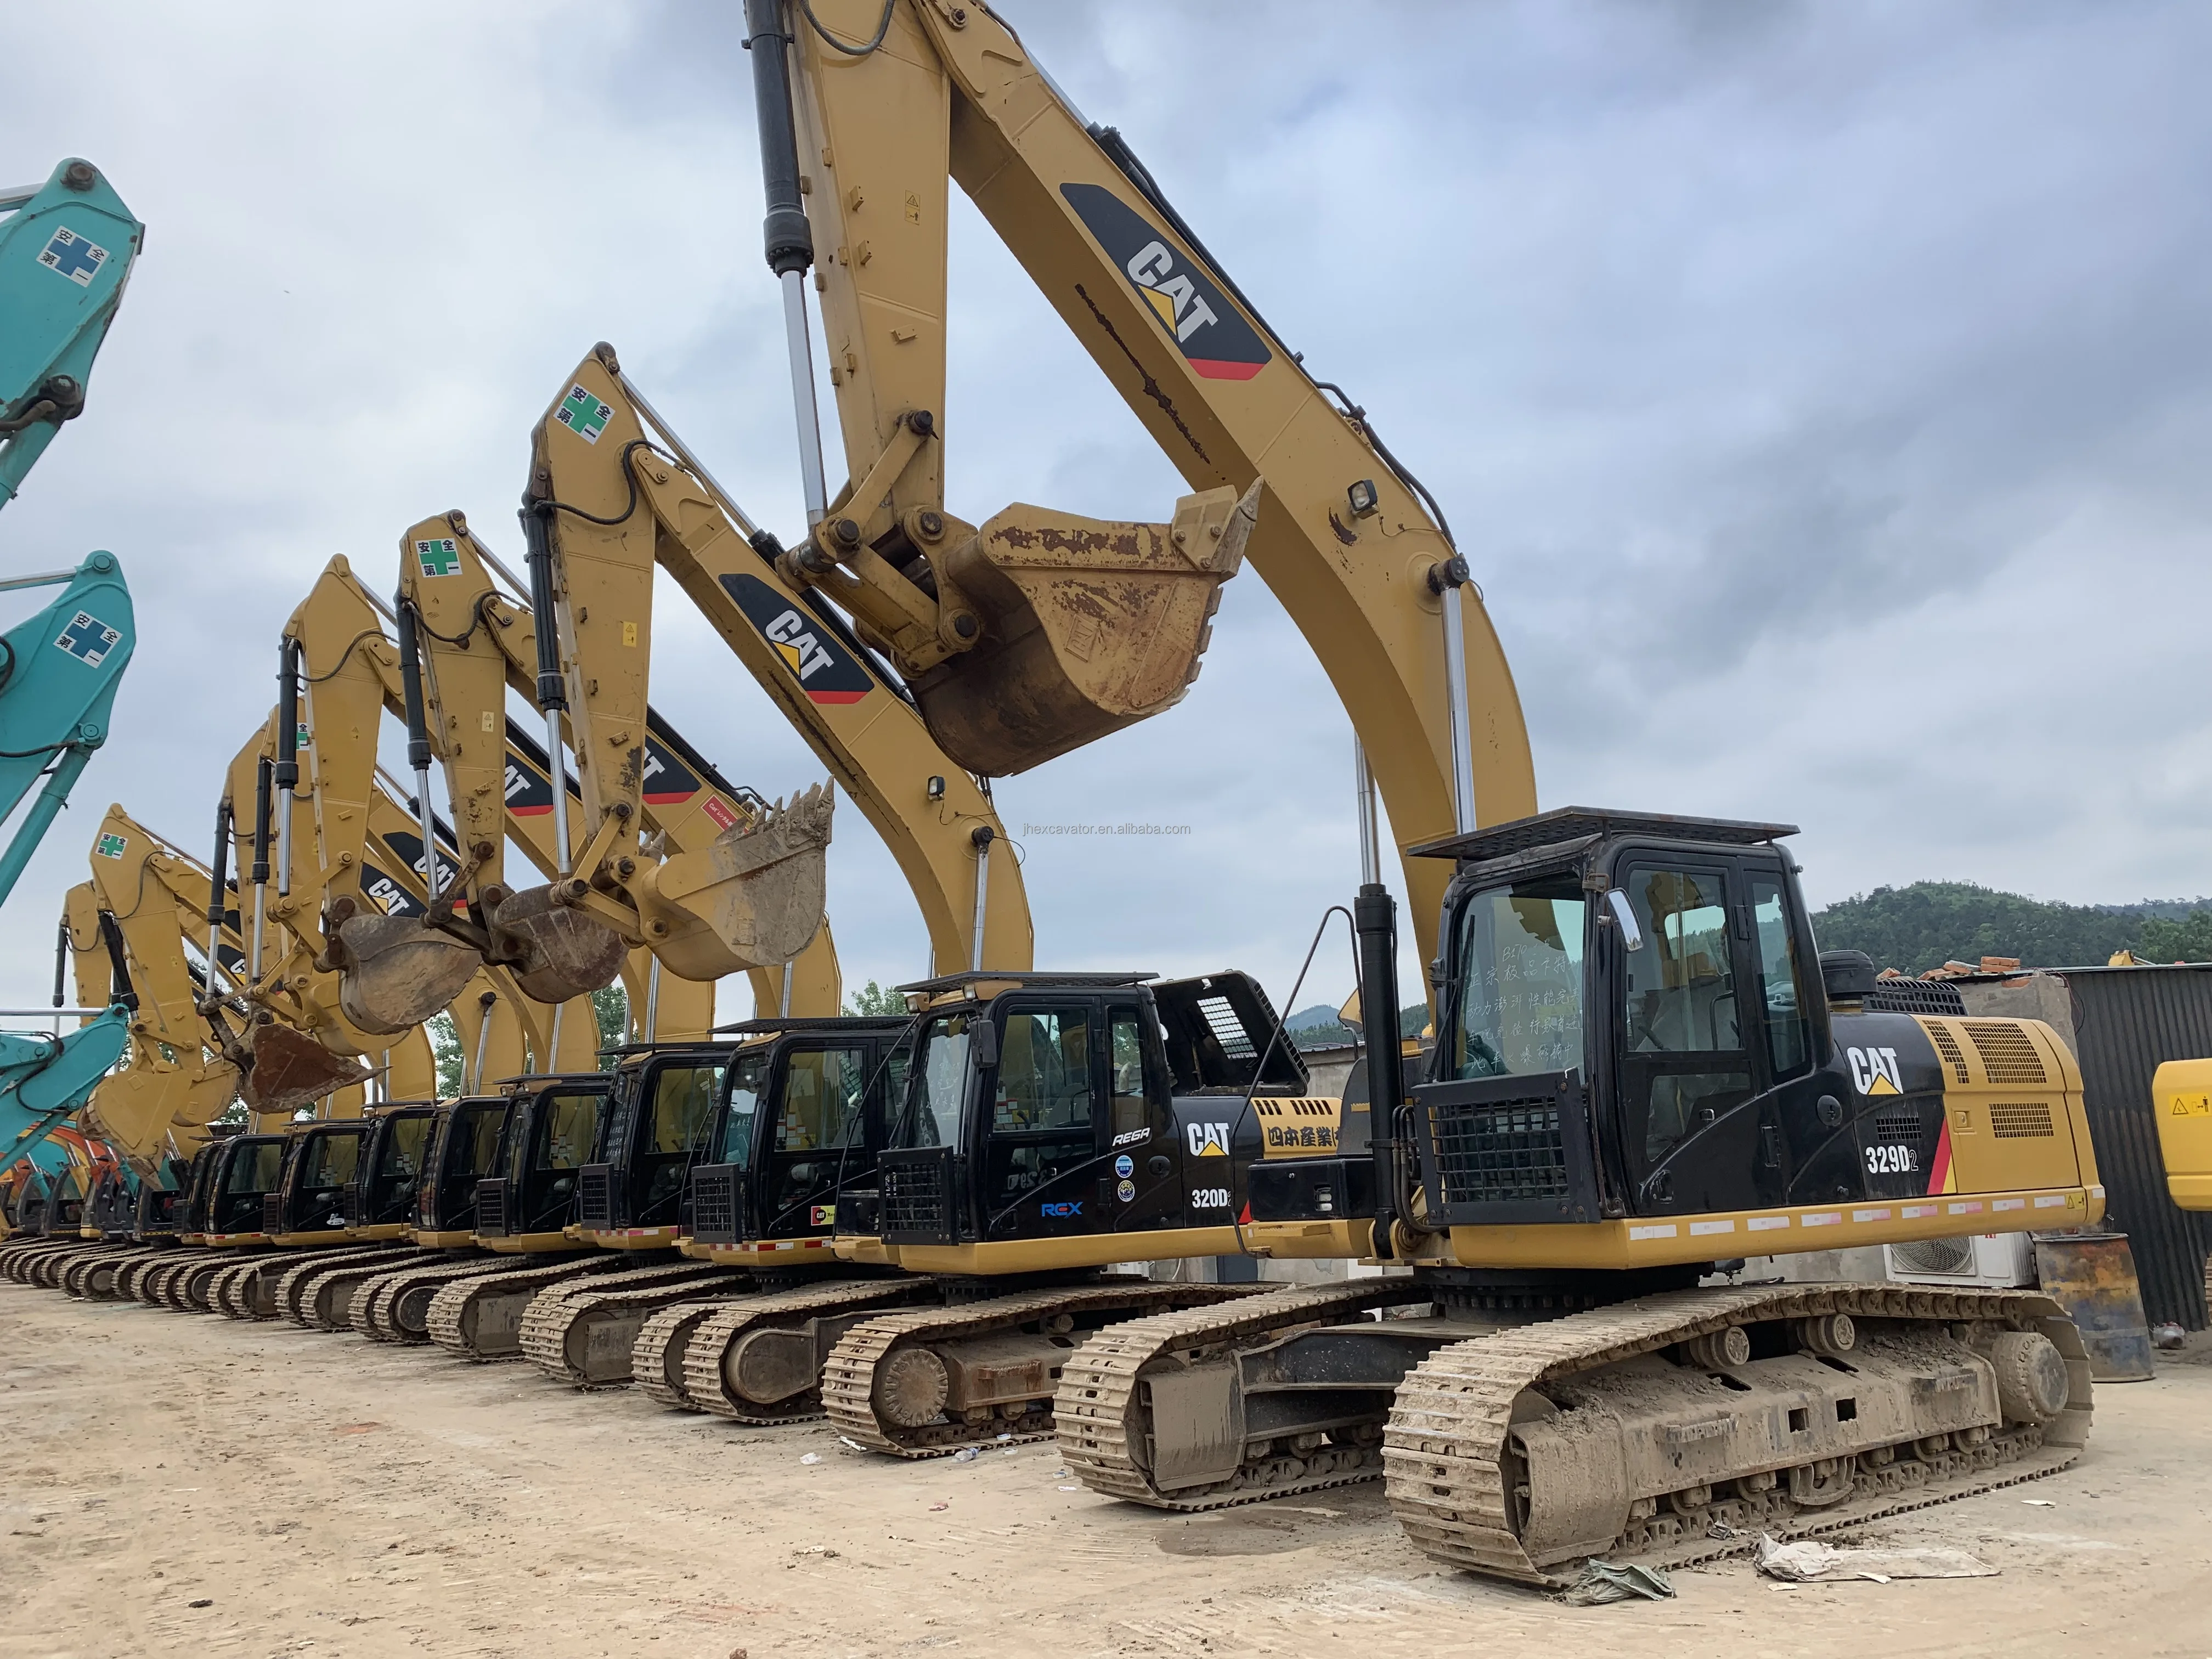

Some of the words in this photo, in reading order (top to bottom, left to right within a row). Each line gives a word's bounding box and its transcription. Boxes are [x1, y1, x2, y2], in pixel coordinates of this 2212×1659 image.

[1127, 241, 1218, 343] CAT
[766, 610, 834, 681] CAT
[505, 765, 532, 801] AT
[368, 878, 409, 916] CAT
[1847, 1047, 1904, 1095] CAT
[1112, 1127, 1150, 1147] REGA
[1187, 1122, 1229, 1156] CAT
[1866, 1145, 1919, 1173] 329D2
[1041, 1201, 1084, 1219] REX
